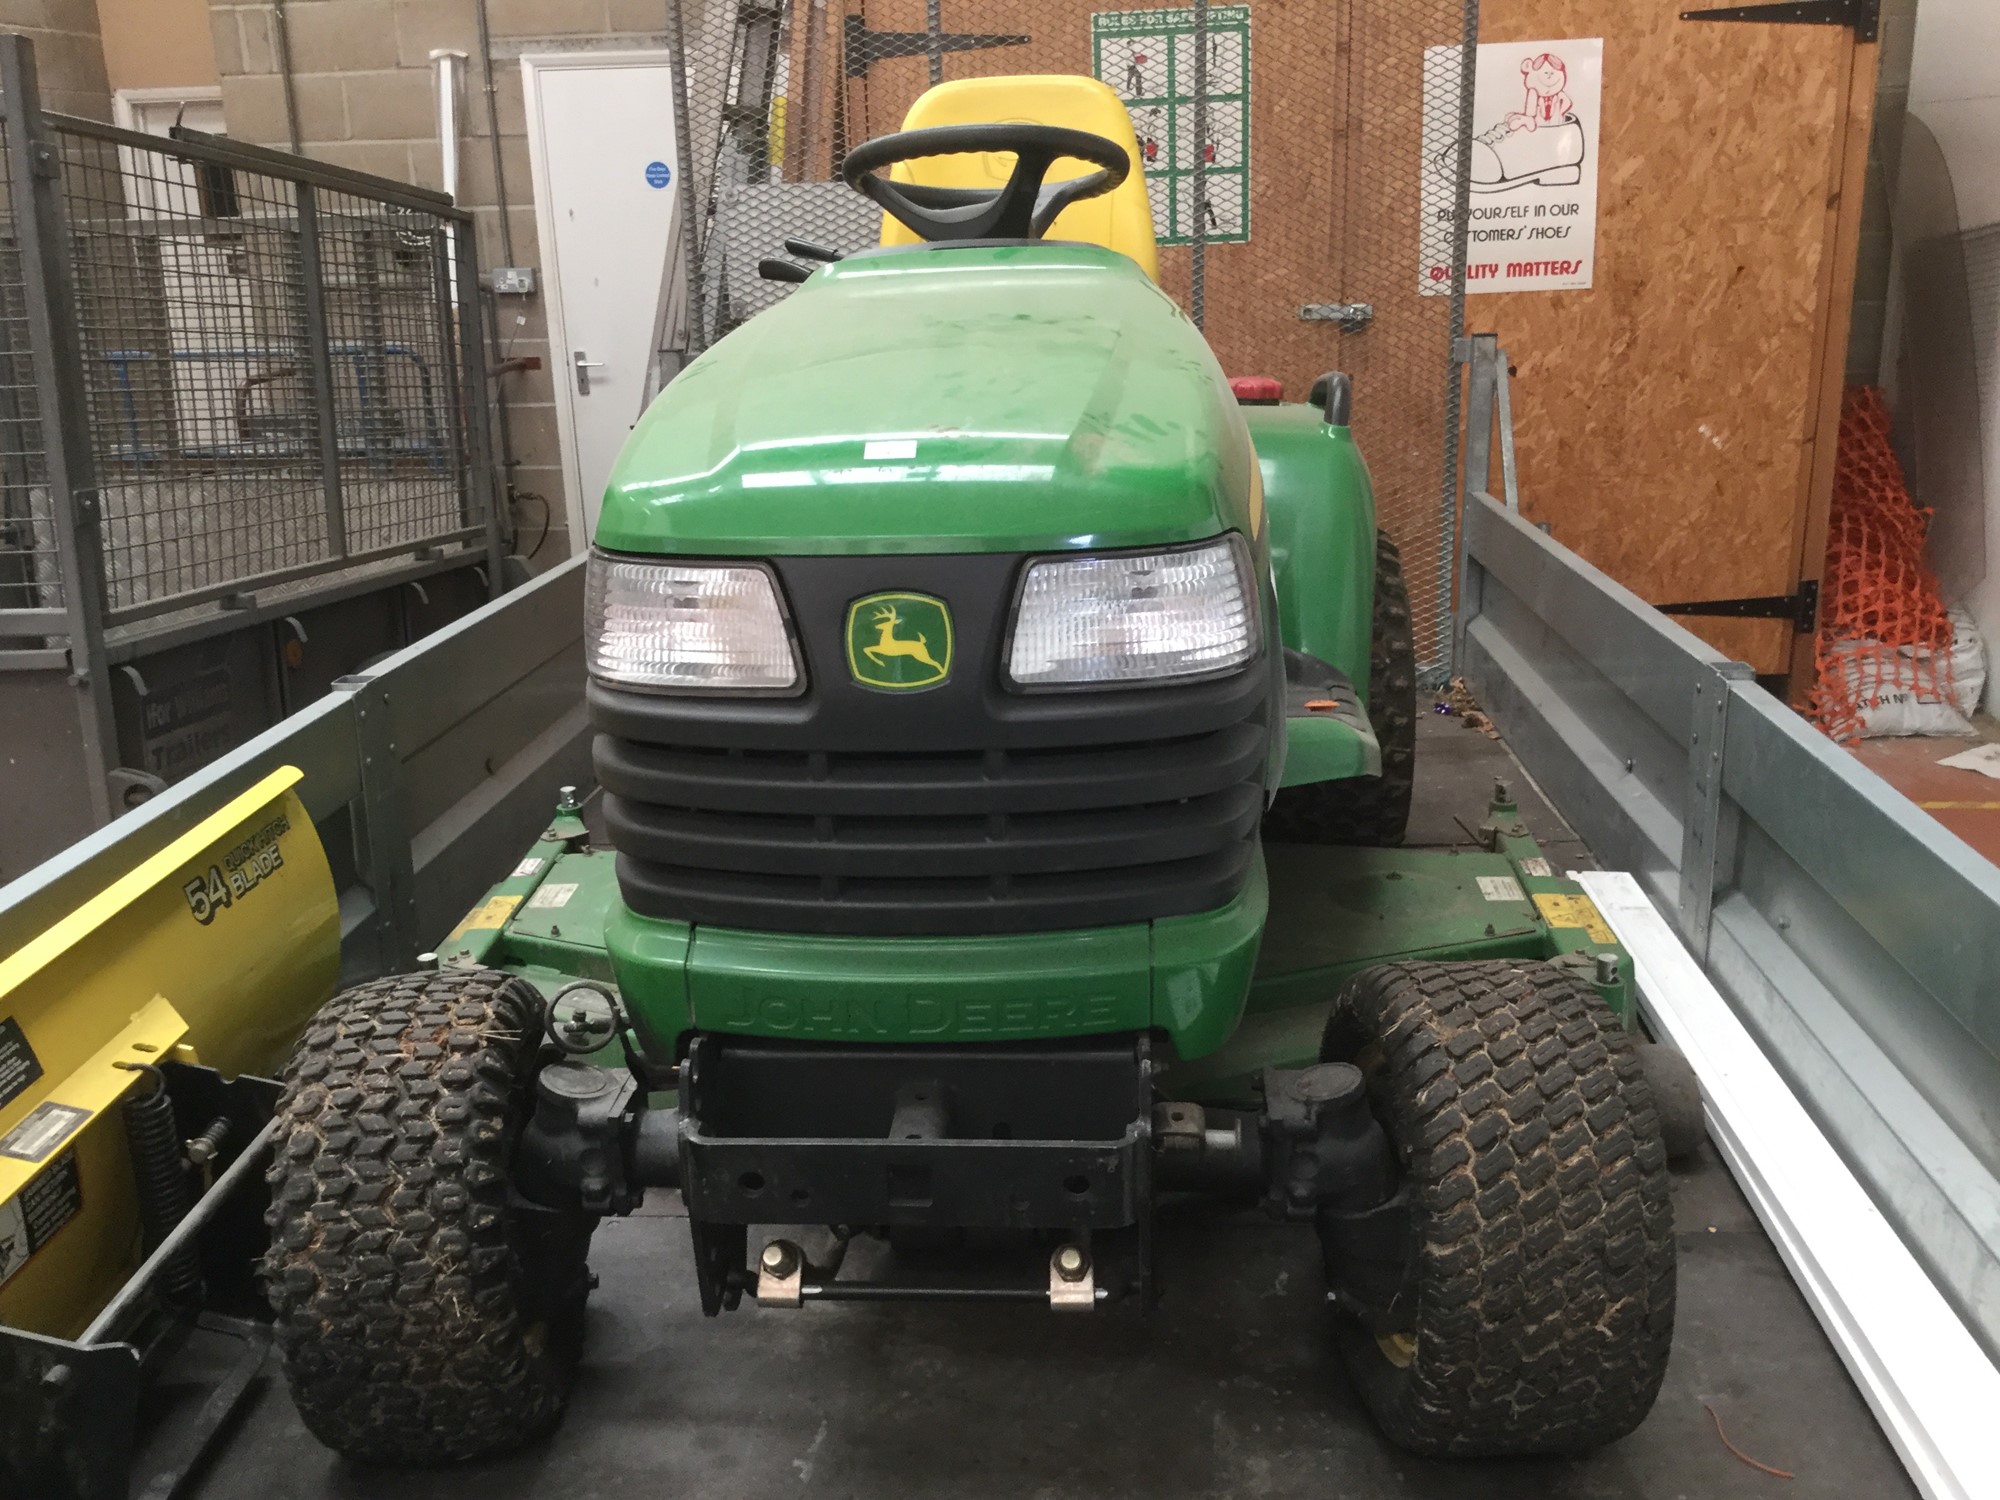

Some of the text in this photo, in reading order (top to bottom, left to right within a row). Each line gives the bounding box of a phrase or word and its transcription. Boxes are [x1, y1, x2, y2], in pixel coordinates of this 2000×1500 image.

[1438, 209, 1456, 222] PU
[1534, 204, 1546, 217] IN
[1550, 203, 1579, 216] OUR
[1527, 226, 1571, 240] SHOES
[1430, 260, 1582, 281] QULITY MATTERS
[183, 843, 284, 925] 54 BLADE
[726, 989, 1117, 1034] JOHN DEERE
